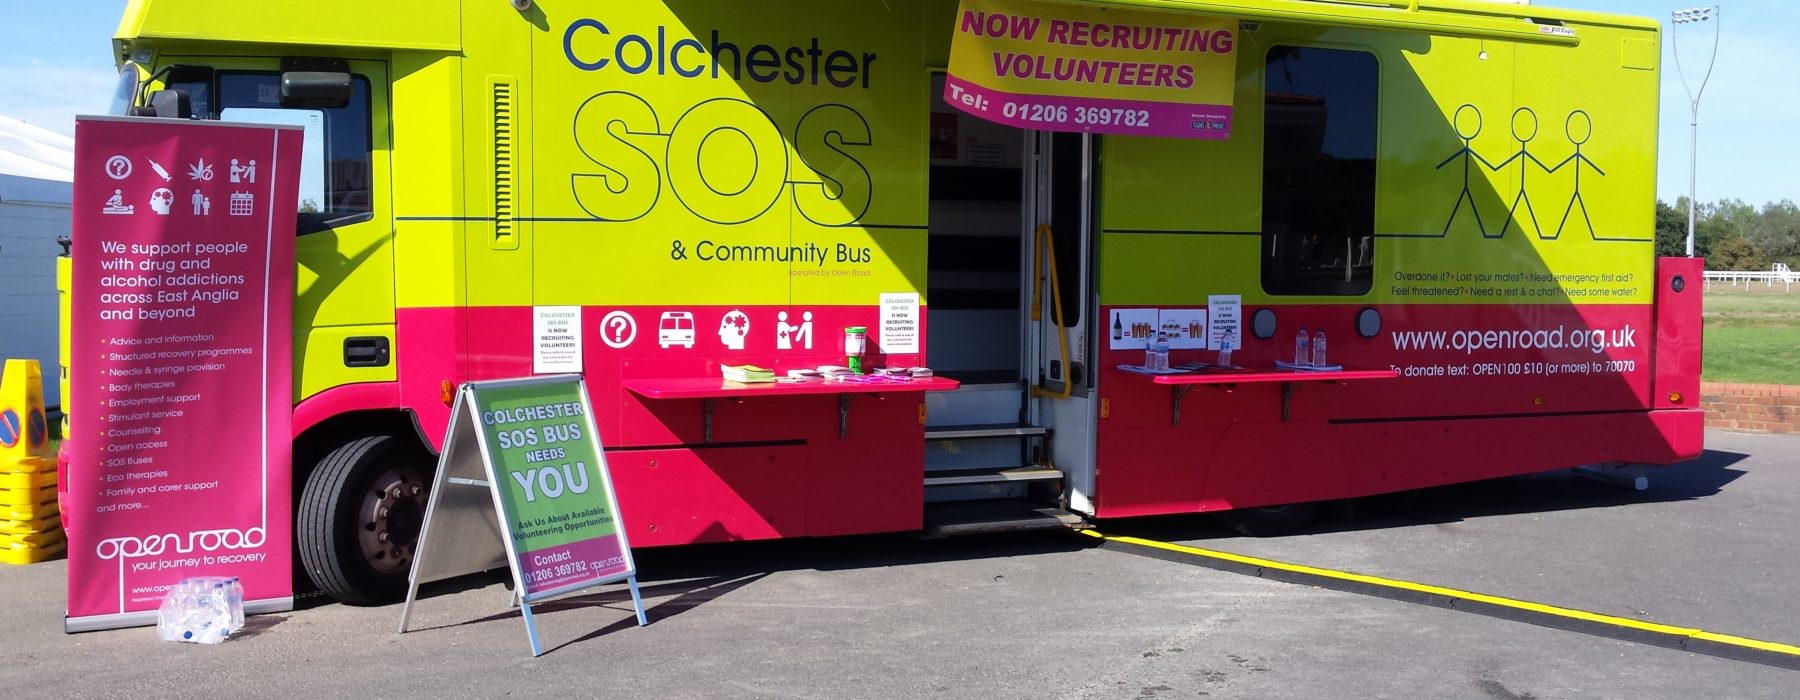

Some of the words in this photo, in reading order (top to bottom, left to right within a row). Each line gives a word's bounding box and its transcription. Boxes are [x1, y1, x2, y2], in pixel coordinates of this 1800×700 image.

[960, 10, 1040, 40] NOW
[1048, 19, 1233, 54] RECRUITING
[562, 18, 876, 89] Colchester
[992, 52, 1194, 89] VOLUNTEERS
[949, 84, 989, 112] Tel:
[1002, 102, 1068, 123] 01206
[1074, 104, 1150, 127] 369782
[572, 90, 872, 227] SOS
[102, 240, 126, 253] We
[132, 241, 190, 256] support
[196, 241, 248, 256] people
[670, 240, 688, 260] &
[696, 240, 828, 267] Community
[836, 243, 872, 264] Bus
[101, 258, 134, 270] with
[139, 258, 175, 273] drug
[180, 258, 210, 270] and
[100, 274, 161, 287] alcohol
[166, 273, 244, 286] addictions
[1395, 272, 1438, 281] Overdone
[1440, 272, 1450, 281] it?
[1456, 272, 1472, 281] Lost
[1474, 274, 1493, 283] your
[1495, 272, 1524, 281] mates?
[1530, 273, 1552, 282] Need
[1554, 274, 1599, 284] emergency
[1601, 273, 1614, 282] first
[1616, 273, 1634, 282] aid?
[100, 293, 152, 304] across
[158, 290, 188, 303] East
[191, 289, 239, 304] Anglia
[1392, 286, 1409, 296] Feel
[1412, 286, 1464, 296] threatened?
[1470, 287, 1493, 296] Need
[1504, 287, 1518, 296] rest
[1520, 287, 1526, 296] &
[1536, 287, 1560, 296] chat?
[1566, 288, 1586, 296] Need
[1612, 288, 1637, 296] water?
[100, 308, 133, 320] and
[138, 305, 195, 321] beyond
[109, 337, 142, 346] Advice
[145, 335, 162, 344] and
[165, 333, 214, 343] information
[1391, 324, 1636, 355] www.openroad.org.uk
[109, 351, 156, 361] Structured
[158, 350, 196, 358] recovery
[197, 346, 252, 358] programmes
[109, 367, 142, 376] Needle
[145, 366, 151, 374] &
[154, 364, 185, 374] syringe
[187, 362, 225, 372] provision
[1404, 364, 1444, 377] donate
[1447, 363, 1469, 376] text:
[1524, 362, 1542, 374] £10
[1545, 361, 1558, 375] (or
[1561, 361, 1590, 374] more)
[1592, 361, 1602, 372] to
[1605, 360, 1635, 372] 70070
[109, 383, 132, 392] Body
[134, 379, 175, 390] therapies
[109, 395, 164, 408] Employment
[166, 393, 200, 403] support
[109, 411, 149, 422] Stimulant
[152, 410, 183, 419] service
[483, 402, 584, 426] COLCHESTER
[108, 426, 160, 437] Counselling
[498, 428, 539, 449] SOS
[543, 422, 582, 444] BUS
[108, 442, 134, 453] Open
[136, 440, 168, 450] access
[108, 458, 125, 467] SOS
[128, 456, 152, 465] Buses
[525, 447, 566, 463] NEEDS
[107, 473, 124, 482] Eco
[126, 469, 168, 480] therapies
[510, 462, 589, 502] YOU
[107, 488, 135, 496] Family
[137, 485, 156, 494] and
[158, 484, 182, 492] carer
[184, 480, 218, 490] support
[97, 504, 115, 513] and
[518, 521, 533, 530] Ask
[535, 518, 546, 526] Us
[548, 513, 570, 524] About
[572, 507, 604, 519] Available
[513, 526, 563, 540] Volunteering
[564, 516, 614, 531] Opportunities
[132, 560, 156, 572] your
[158, 558, 200, 571] journey
[203, 555, 214, 565] to
[217, 553, 266, 564] recovery
[534, 550, 572, 566] Contact
[525, 569, 553, 584] 01206
[555, 561, 587, 576] 369782
